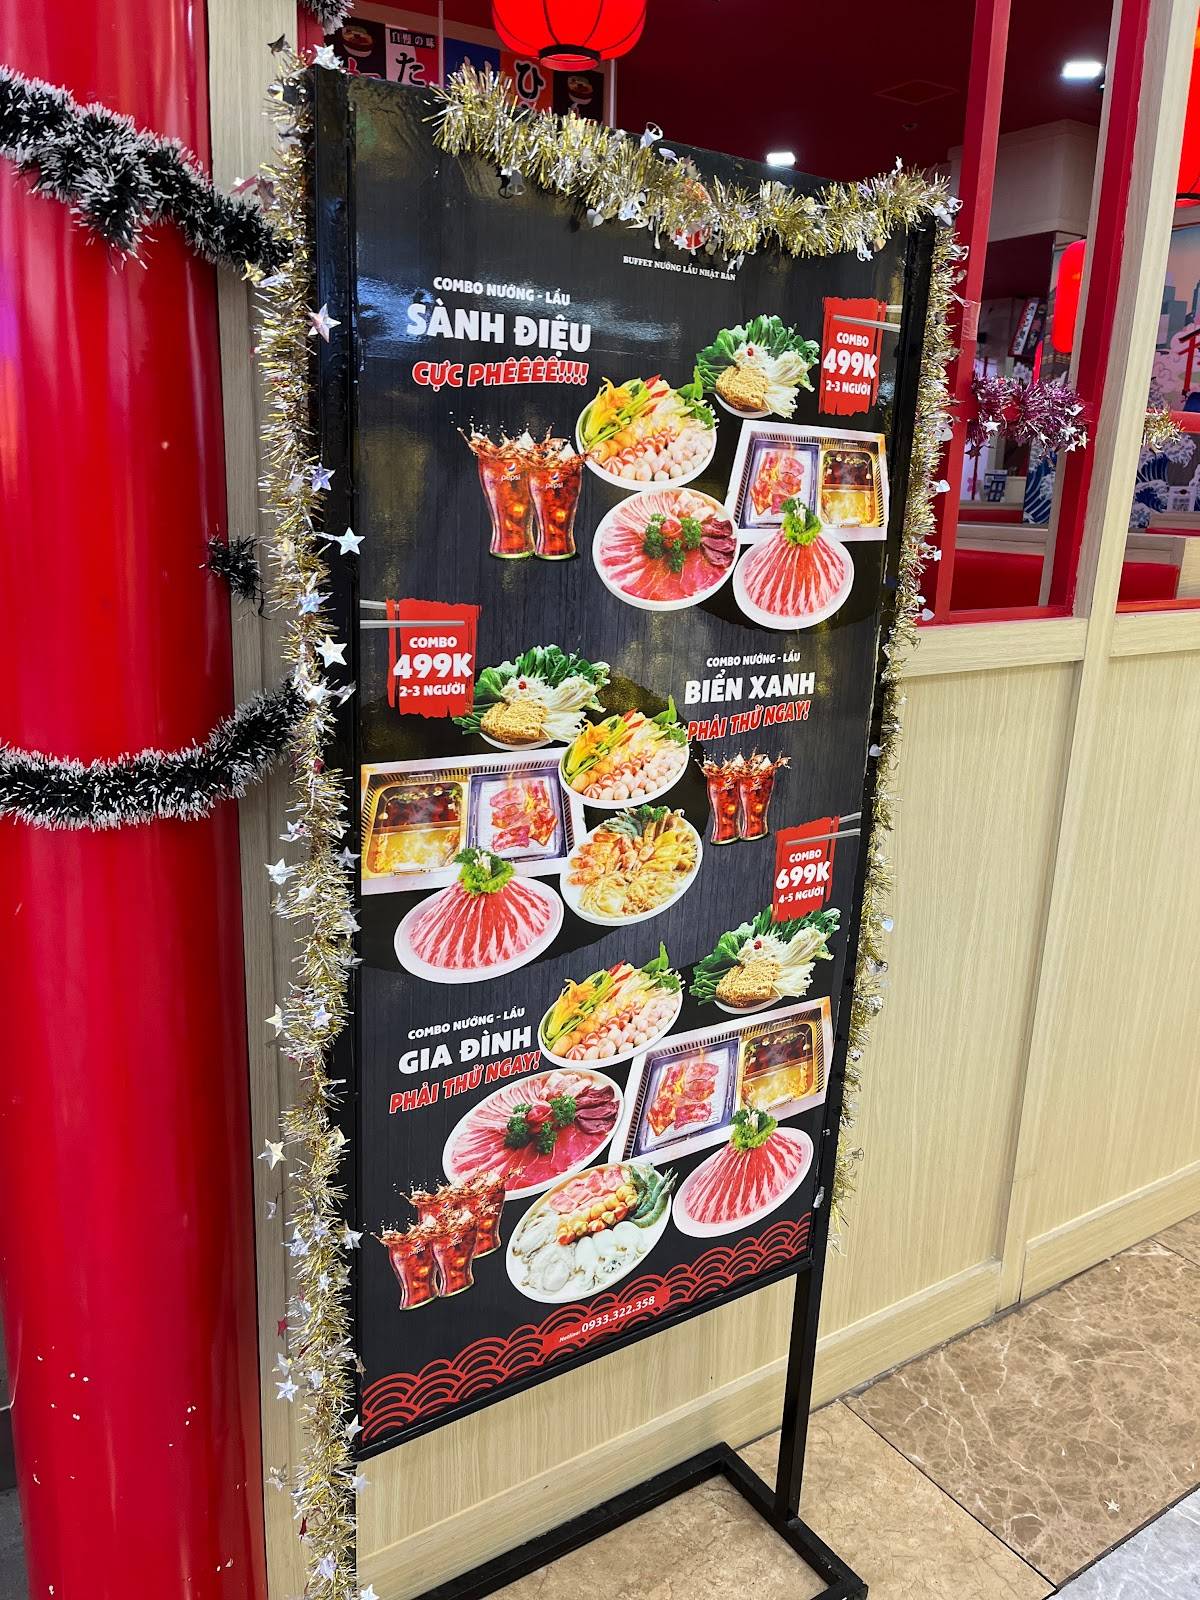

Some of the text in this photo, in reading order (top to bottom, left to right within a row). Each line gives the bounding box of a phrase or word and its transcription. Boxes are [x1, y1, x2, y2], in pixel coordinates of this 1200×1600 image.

[623, 256, 653, 268] BUFFET
[433, 276, 484, 295] COMBO
[486, 283, 534, 301] NƯỚNG
[406, 297, 591, 357] SÀNH ĐIỆU
[836, 332, 869, 347] COMBO
[412, 360, 464, 392] CỰC
[823, 348, 878, 379] 499K
[826, 380, 840, 392] 2-3
[501, 474, 520, 482] pepsi
[409, 636, 457, 648] COMBO
[392, 652, 473, 679] 499K
[706, 656, 740, 668] COMBO
[400, 685, 420, 697] 2-3
[685, 669, 816, 705] BIỂN XANH
[687, 700, 811, 741] PHẢI THỬ NGAY!
[789, 849, 822, 863] COMBO
[776, 860, 831, 890] 699K
[778, 892, 793, 904] 4-5
[408, 1023, 450, 1040] COMBO
[398, 1025, 532, 1075] GIA ĐÌNH
[389, 1050, 541, 1114] PHẢI THỬ NGAY!
[581, 1295, 655, 1333] 0933.322.358
